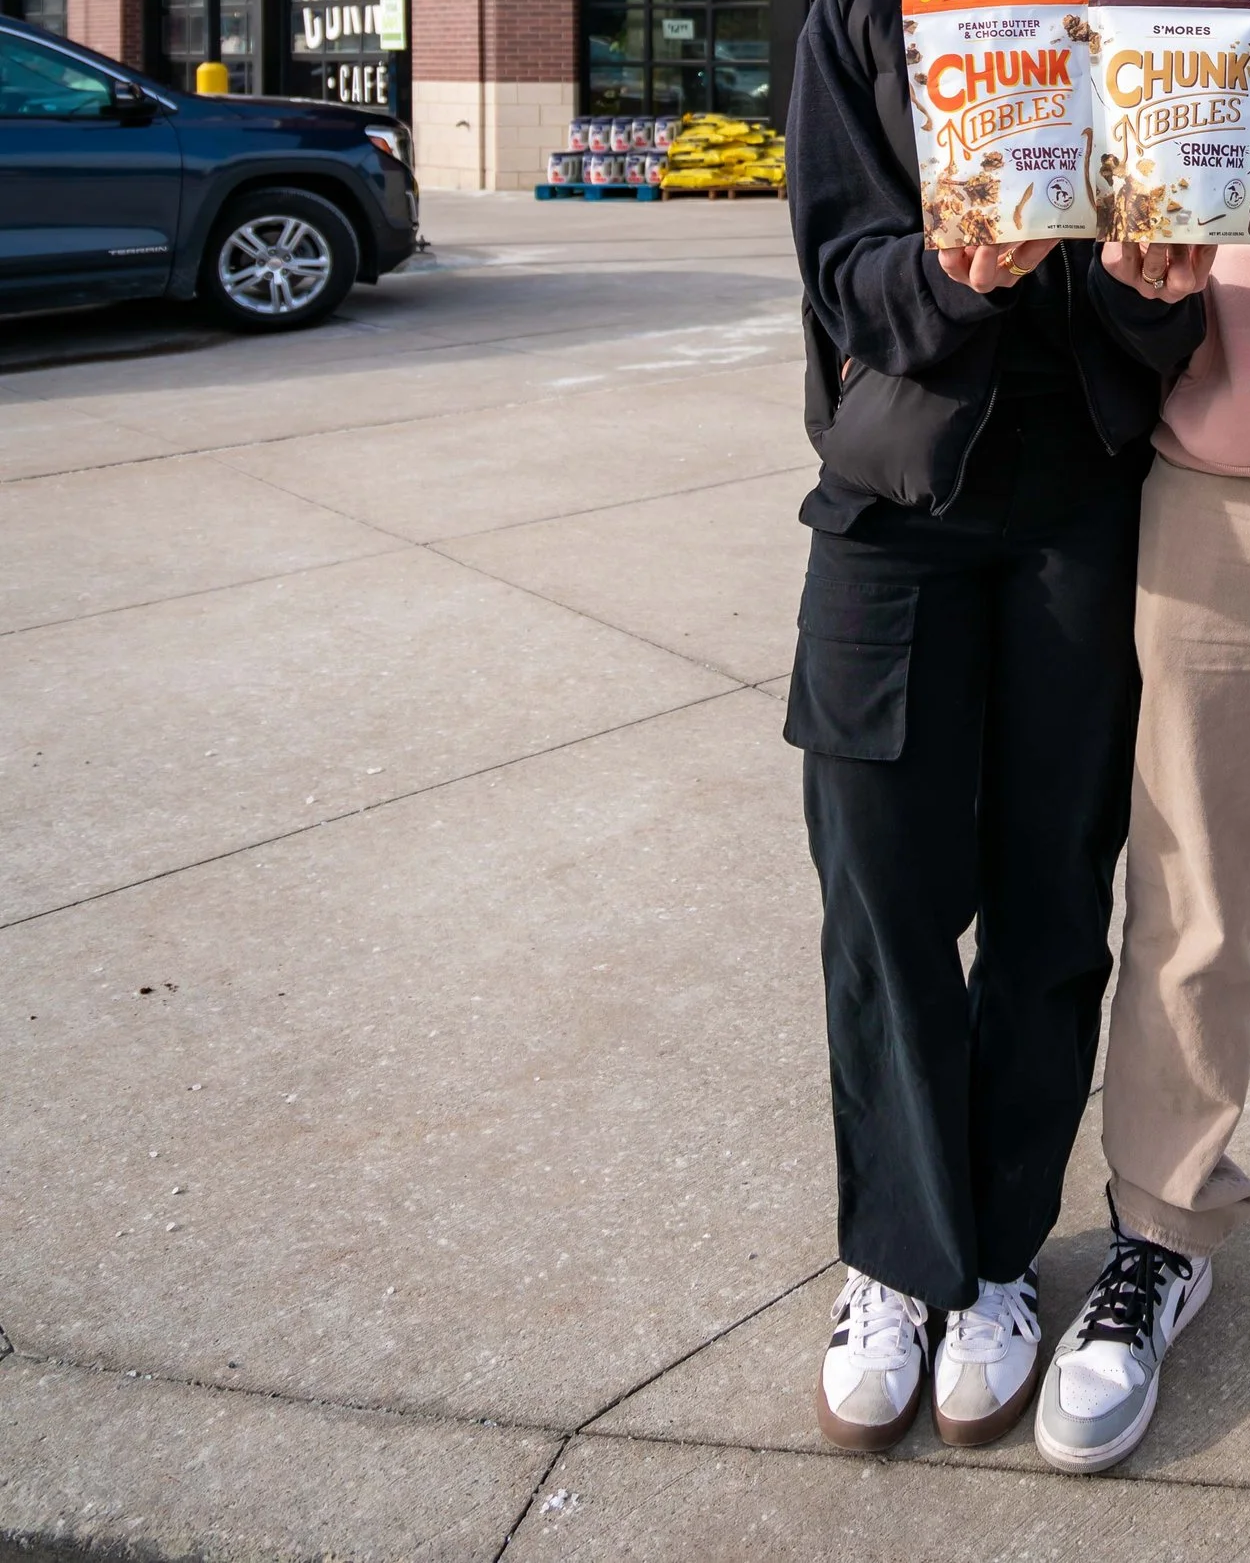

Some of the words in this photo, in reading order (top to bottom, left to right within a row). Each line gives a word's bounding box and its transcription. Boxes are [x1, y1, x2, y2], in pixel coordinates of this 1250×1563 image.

[958, 20, 998, 30] PEANUT
[1002, 20, 1040, 28] BUTTER
[1153, 26, 1211, 35] S'MORES
[964, 30, 970, 38] &
[976, 29, 1036, 38] CHOCOLATE
[926, 49, 1072, 113] CHUNK
[1106, 49, 1250, 108] CHUNK
[936, 91, 1071, 172] NIBBLES
[1112, 94, 1246, 165] NIBBLES
[1011, 147, 1078, 160] CRUNCHY
[1181, 144, 1246, 157] CRUNCHY
[1016, 160, 1056, 171] SNACK
[1060, 160, 1076, 171] MIX
[1183, 156, 1222, 167] SNACK
[1226, 157, 1244, 168] MIX
[108, 246, 167, 256] TERRAIN
